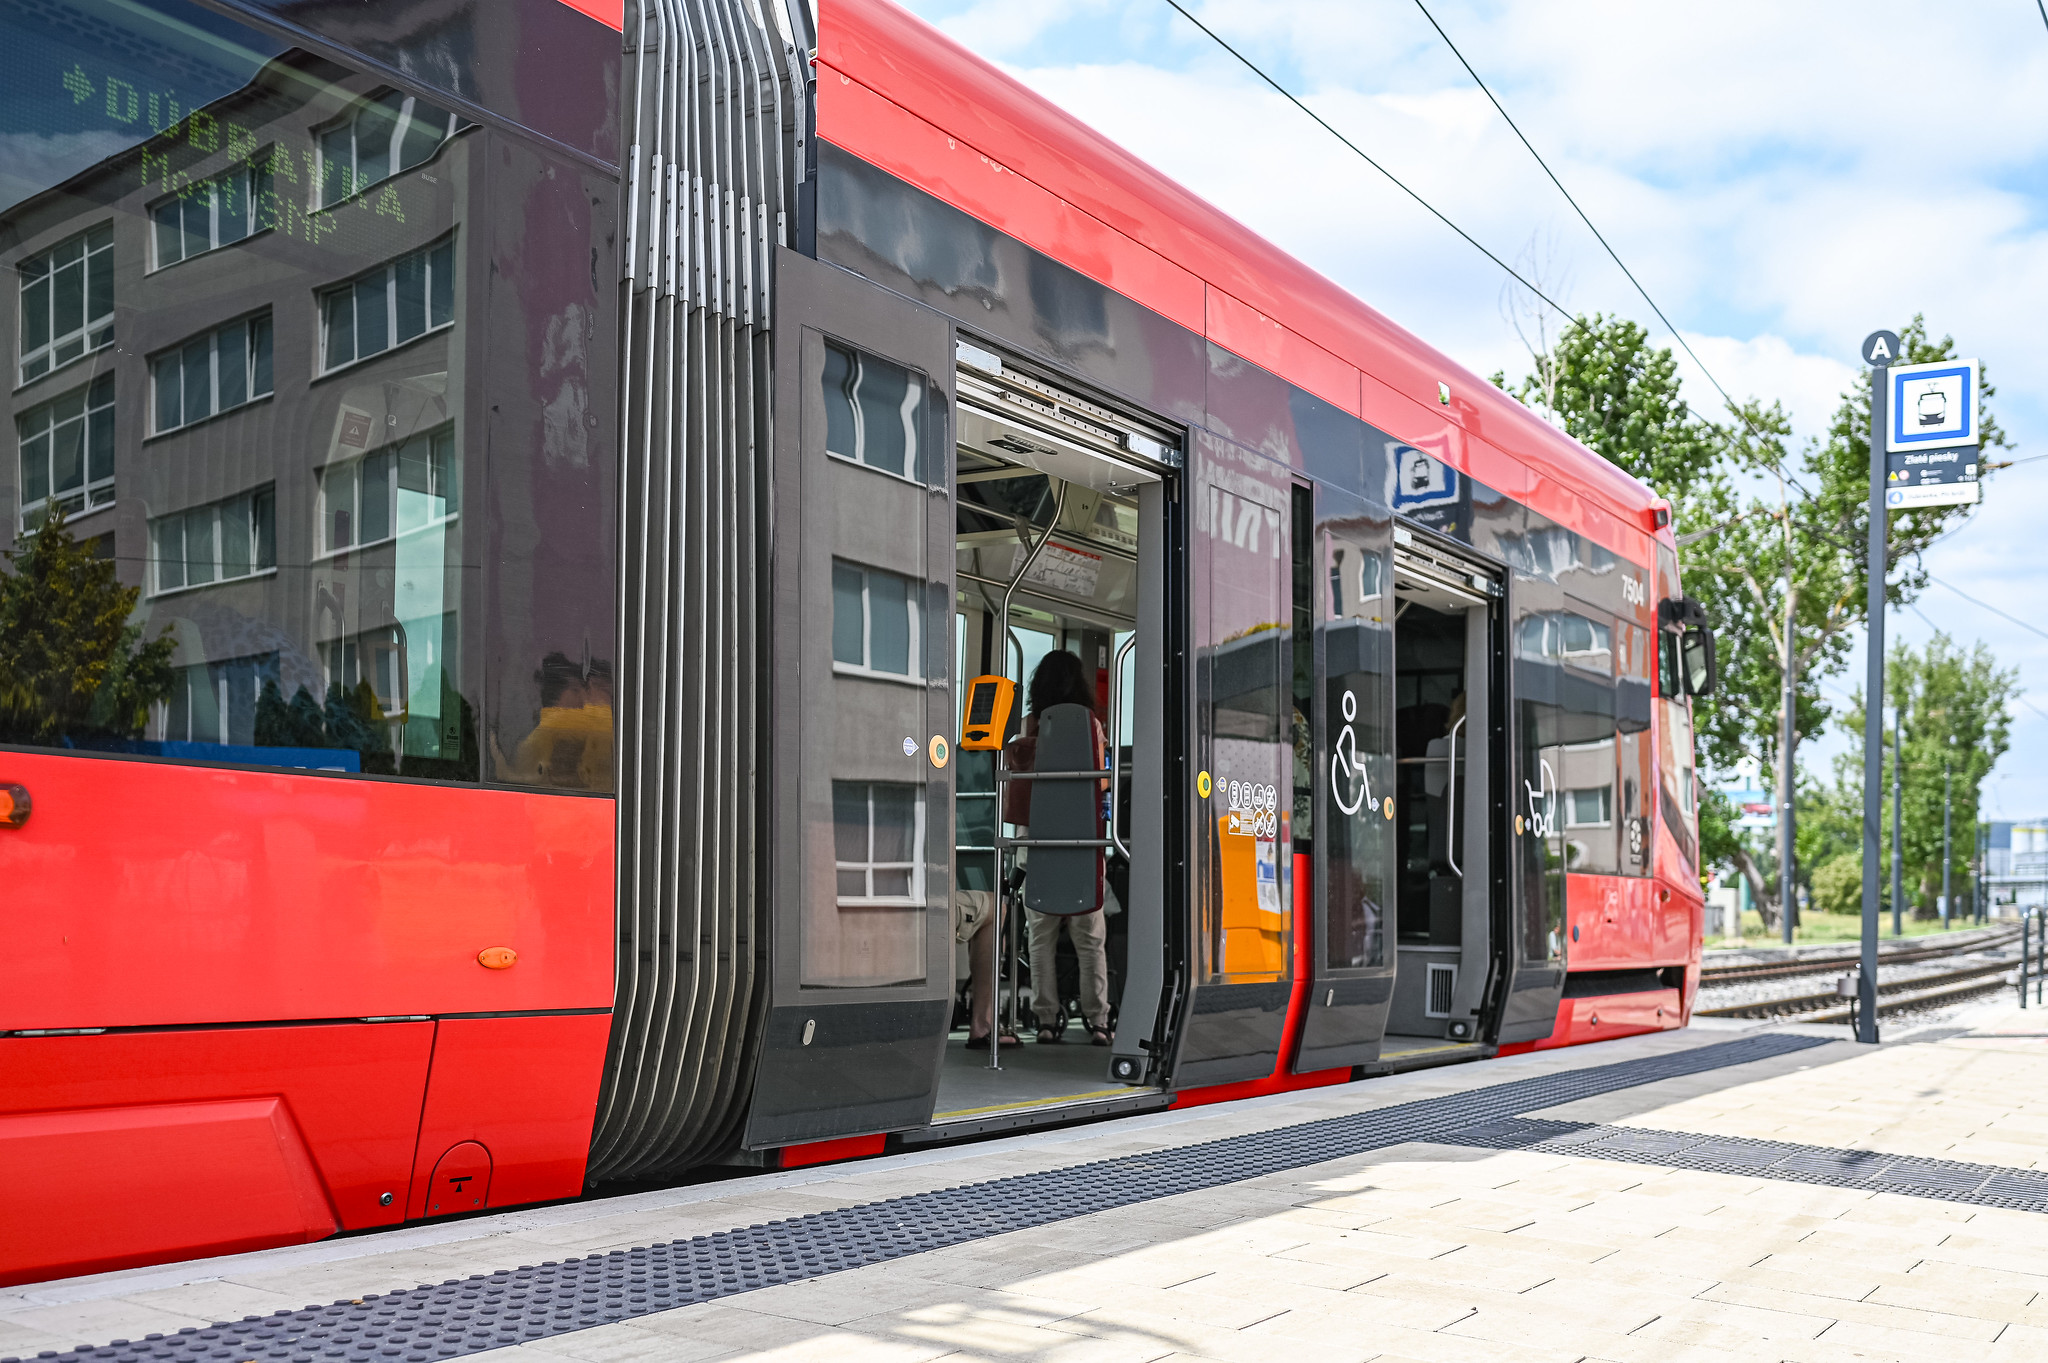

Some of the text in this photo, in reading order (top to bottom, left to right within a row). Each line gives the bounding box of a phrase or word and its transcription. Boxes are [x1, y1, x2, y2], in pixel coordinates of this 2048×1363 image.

[141, 146, 338, 245] Most SNP
[1869, 336, 1892, 361] A
[1621, 573, 1644, 607] 7504
